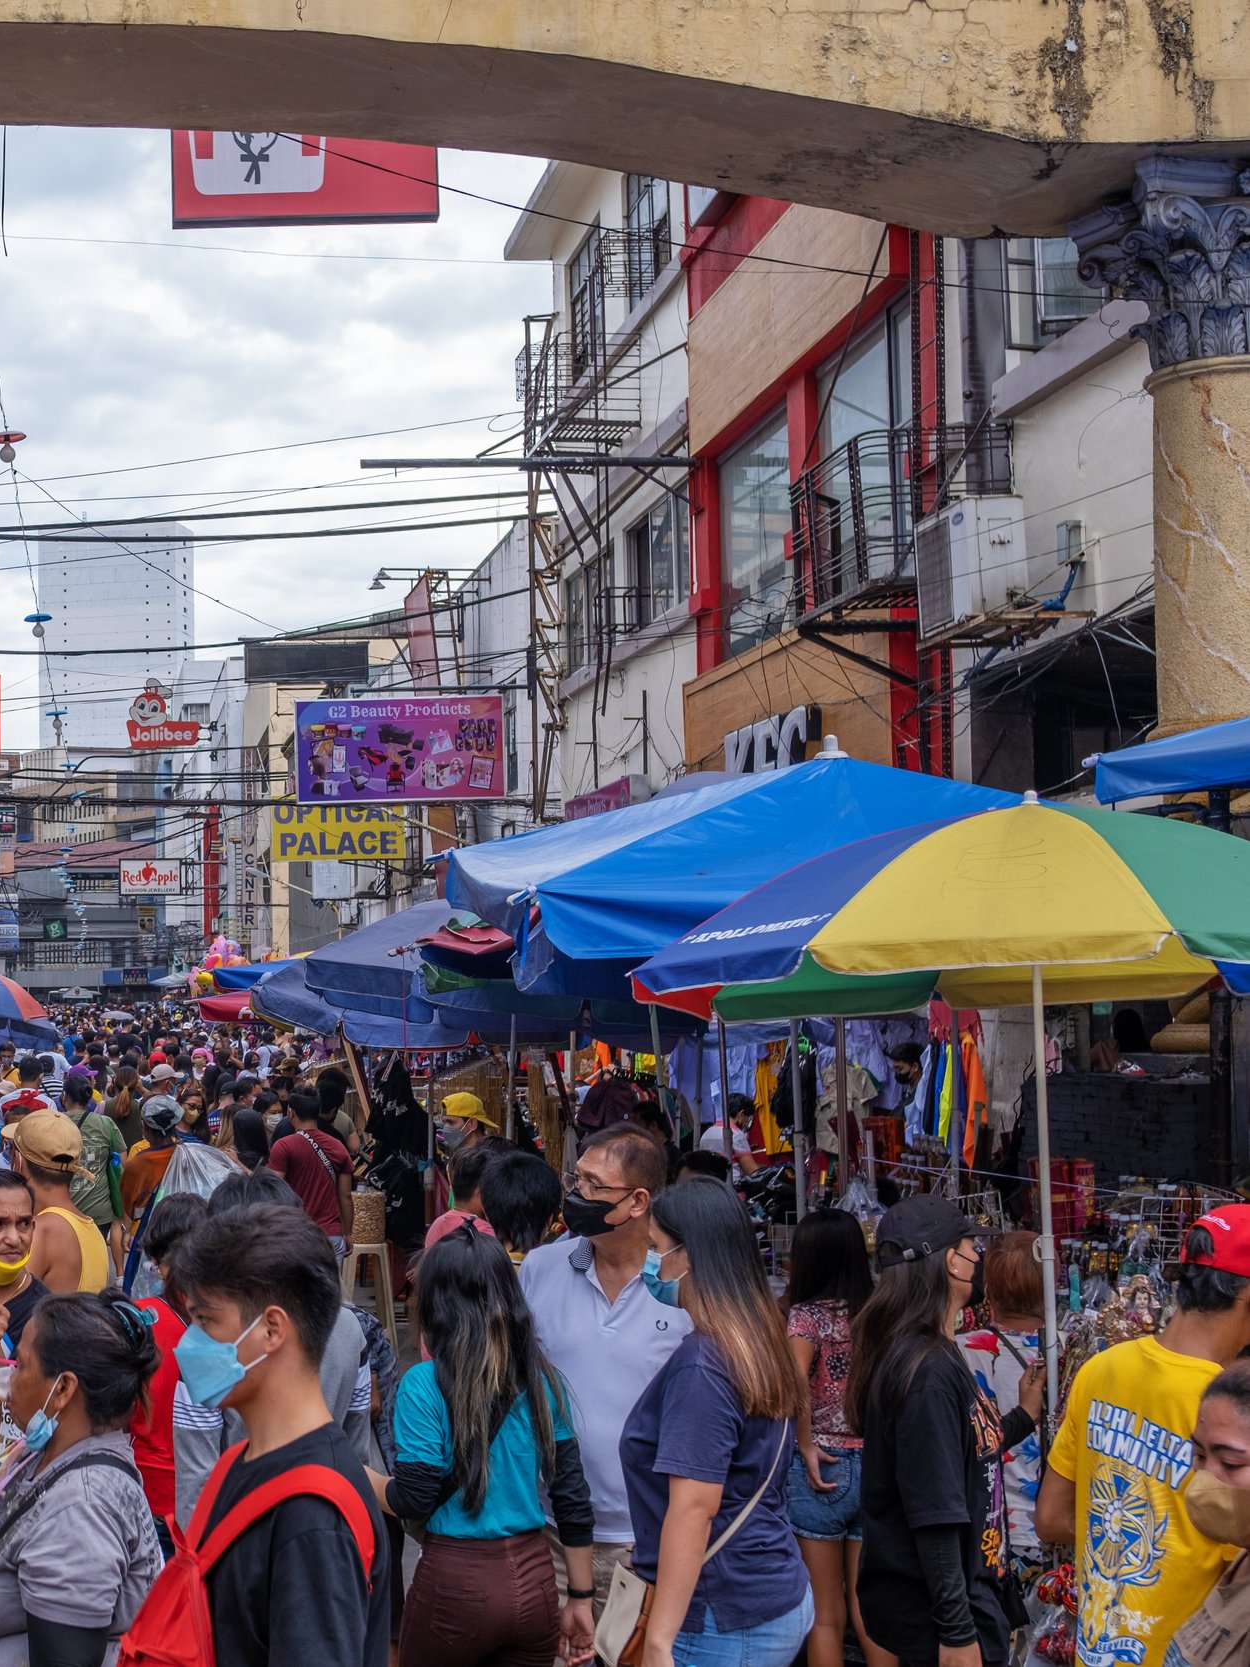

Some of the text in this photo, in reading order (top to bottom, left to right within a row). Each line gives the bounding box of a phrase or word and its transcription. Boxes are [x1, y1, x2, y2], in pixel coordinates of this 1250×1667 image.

[328, 703, 471, 719] G2 Beauty Products
[131, 726, 193, 741] Jollibee
[280, 831, 398, 856] PALACE
[122, 870, 142, 886] Red
[1088, 1399, 1194, 1467] ALPHA DELTA
[1087, 1421, 1190, 1490] COMMUNITY
[1098, 1638, 1138, 1651] SERVICE
